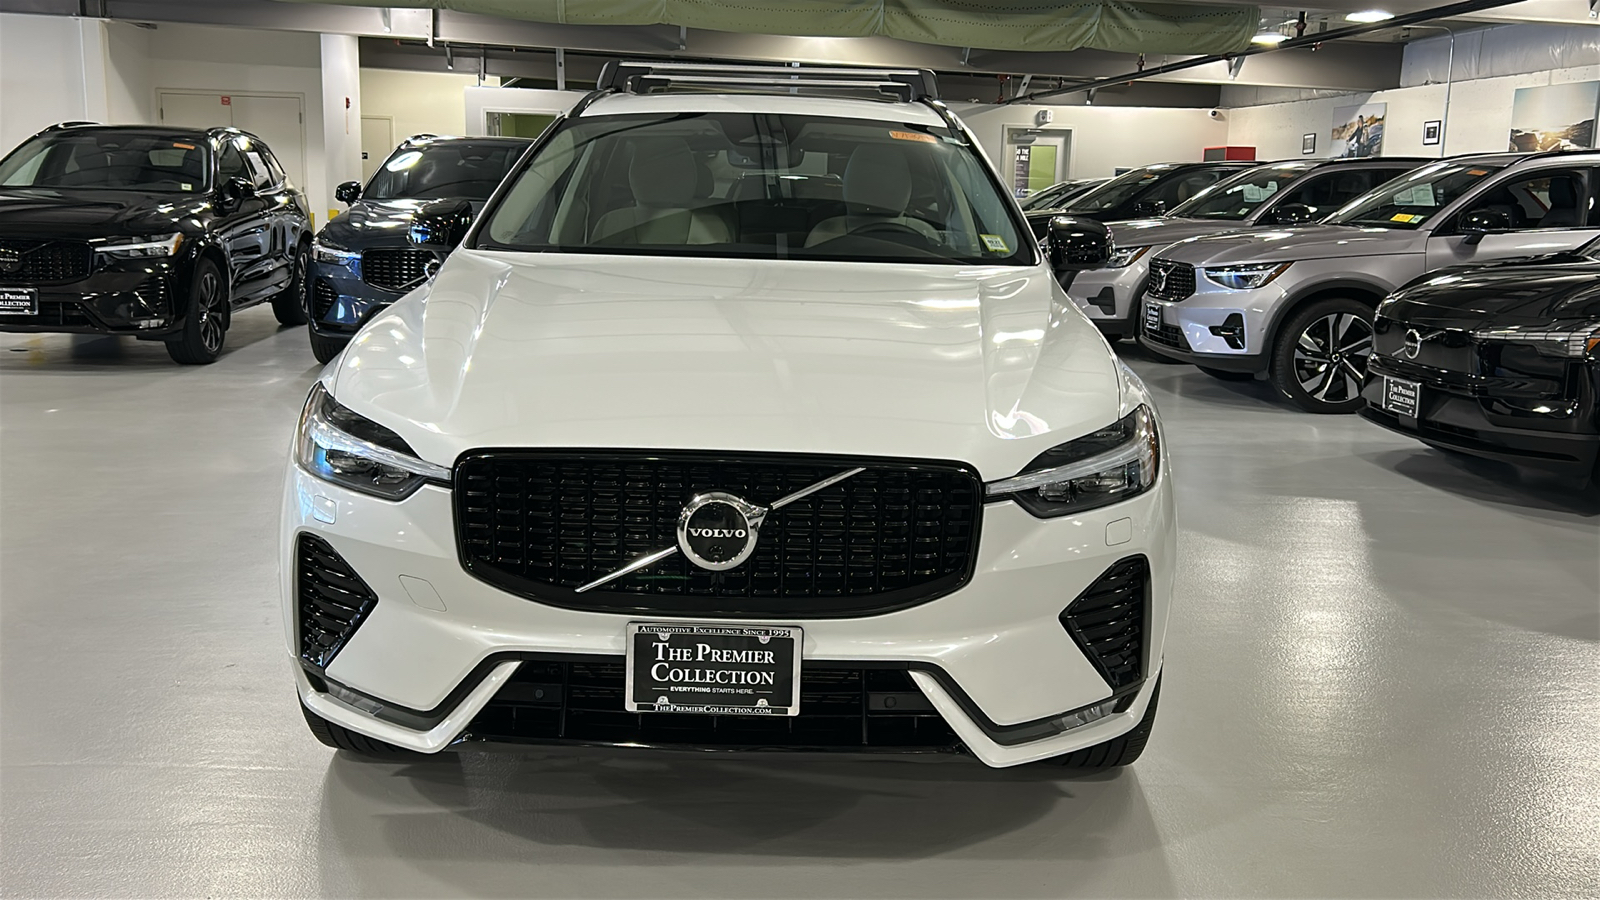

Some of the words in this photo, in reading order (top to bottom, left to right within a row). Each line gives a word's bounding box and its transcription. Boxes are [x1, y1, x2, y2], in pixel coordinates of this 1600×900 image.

[688, 527, 746, 538] VOLVO
[693, 626, 741, 635] EXCELLENCE
[742, 628, 767, 636] SINCE
[768, 629, 790, 638] 1995
[652, 642, 692, 661] THE
[696, 643, 775, 664] PREMIER
[651, 662, 775, 685] COLLECTION
[653, 704, 772, 714] THEPREMIERCOLLECTION.COM
